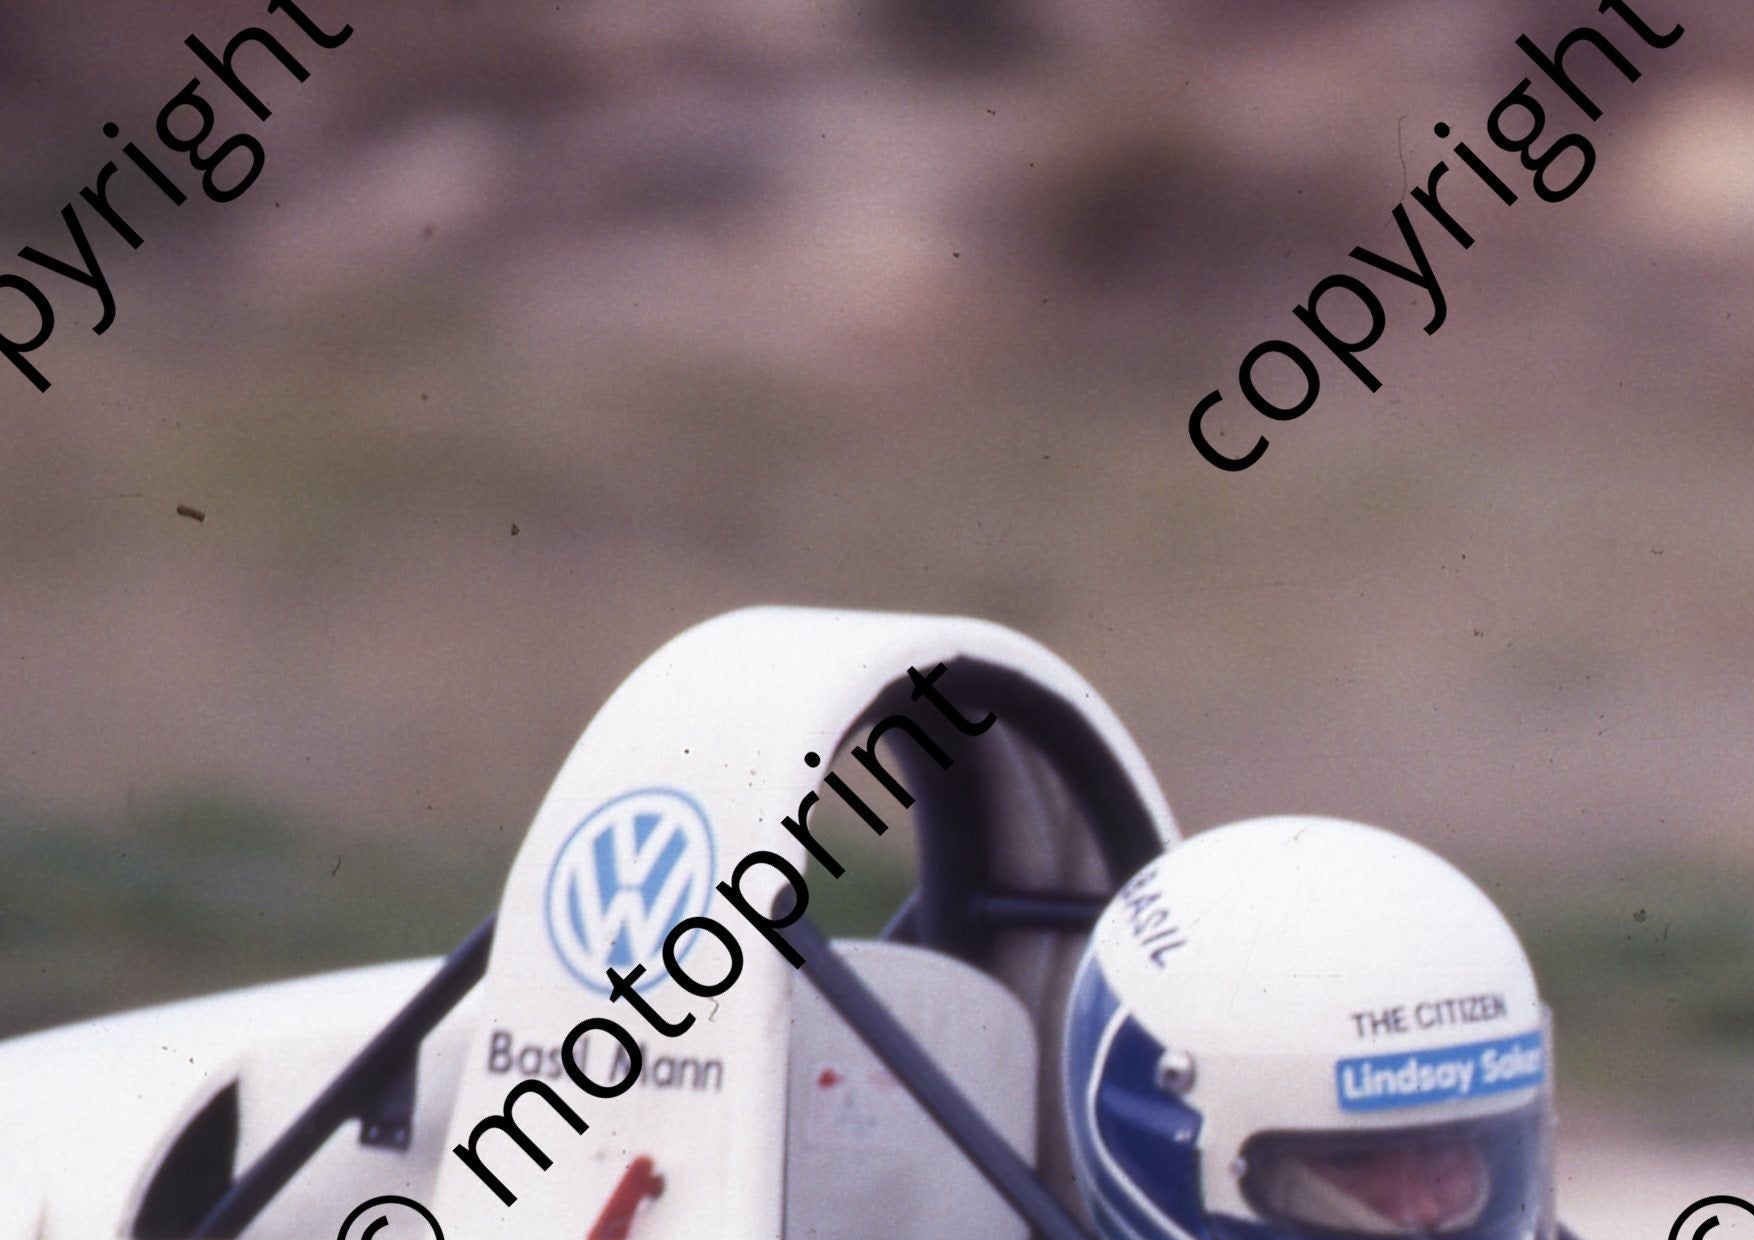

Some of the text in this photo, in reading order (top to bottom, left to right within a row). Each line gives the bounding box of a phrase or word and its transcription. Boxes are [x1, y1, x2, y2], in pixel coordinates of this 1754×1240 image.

[1351, 1006, 1409, 1038] THE
[487, 1029, 724, 1092] Basl Mann
[1342, 1056, 1475, 1101] Lindsay
